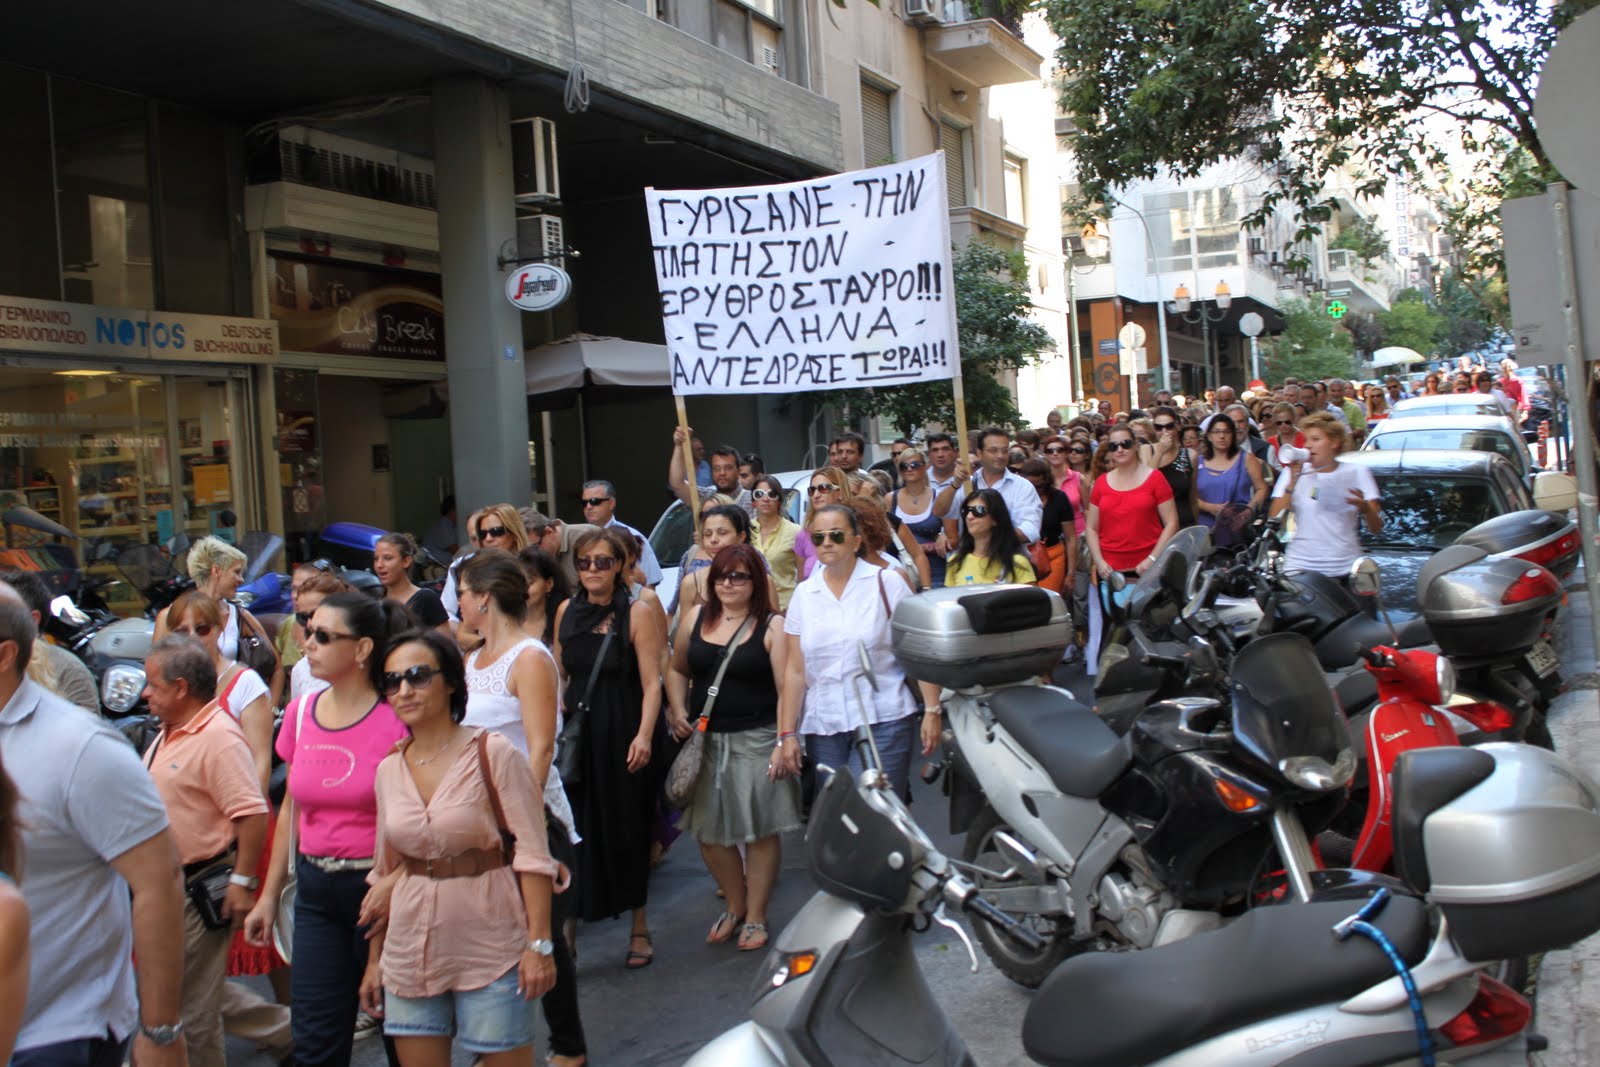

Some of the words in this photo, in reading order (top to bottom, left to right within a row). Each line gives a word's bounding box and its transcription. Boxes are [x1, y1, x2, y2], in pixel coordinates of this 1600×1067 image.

[658, 185, 841, 237] ΓΥΡΙΣΑΝΕ
[853, 168, 925, 219] ΤΗΝ
[95, 315, 186, 350] NOTOS
[221, 324, 273, 340] DEUTSCHE
[382, 314, 436, 343] Break
[694, 306, 898, 351] ΕΛΛΗΝΑ
[193, 339, 274, 356] BUCHHANDLUNG
[673, 352, 847, 388] ΑΝΤΕΔΡΑΣΕ
